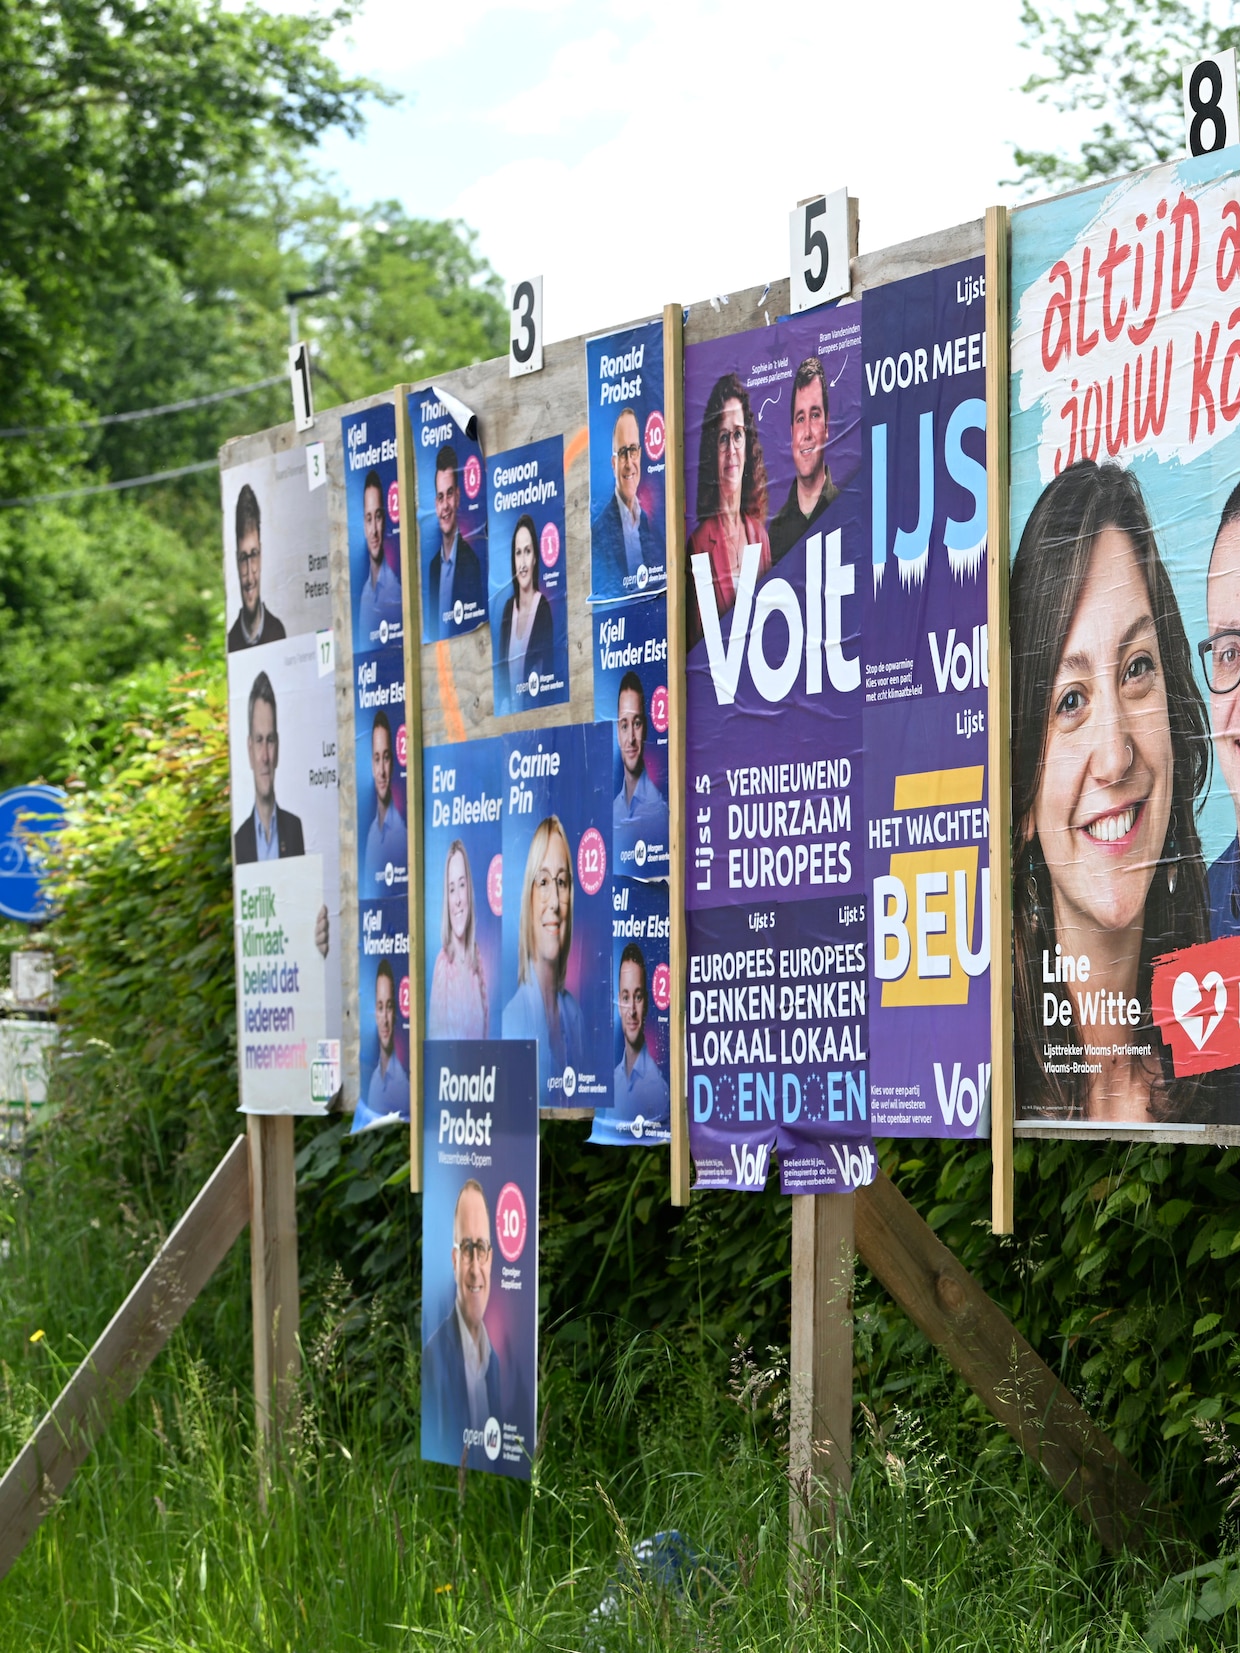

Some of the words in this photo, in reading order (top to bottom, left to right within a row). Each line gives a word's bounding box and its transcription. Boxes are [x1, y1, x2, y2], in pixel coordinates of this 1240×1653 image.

[1188, 59, 1227, 157] 8
[804, 197, 829, 293] 5
[956, 275, 986, 306] Lijst
[512, 281, 536, 364] 3
[600, 344, 644, 379] Ronald
[865, 347, 929, 397] VOOR
[294, 346, 311, 418] 1
[600, 375, 642, 406] Probst
[1054, 340, 1173, 477] jouw
[347, 421, 368, 449] Kjell
[421, 422, 453, 448] Geyns
[649, 428, 662, 446] 10
[469, 469, 476, 485] 6
[493, 460, 539, 488] Gewoon
[493, 479, 558, 513] Gwendolyn.
[308, 554, 328, 573] Bram
[304, 582, 330, 599] Peters
[600, 617, 625, 649] Kjell
[690, 526, 862, 706] Volt
[320, 641, 330, 665] 17
[600, 642, 644, 671] Vander
[643, 637, 668, 664] Elst
[357, 661, 377, 686] Kjell
[358, 685, 390, 709] Vander
[657, 700, 665, 719] 2
[956, 709, 985, 739] Lijst
[322, 740, 336, 758] Luc
[508, 744, 561, 780] Carine
[432, 764, 456, 794] Eva
[695, 774, 711, 794] 5
[726, 757, 852, 796] VERNIEUWEND
[432, 800, 450, 828] De
[451, 792, 503, 826] Bleeker
[508, 783, 534, 815] Pin
[728, 795, 852, 840] DUURZAAM
[868, 817, 903, 849] HET
[584, 848, 598, 873] 12
[695, 806, 715, 890] Lijst
[728, 841, 853, 889] EUROPEES
[241, 884, 276, 928] Eerlijk
[362, 909, 382, 933] Kjell
[749, 912, 768, 932] Lijst
[768, 911, 775, 928] 5
[838, 906, 858, 927] Lijst
[858, 904, 865, 921] 5
[241, 925, 289, 958] klimaat-
[363, 934, 394, 956] Vander
[690, 948, 776, 983] EUROPEES
[779, 943, 866, 979] EUROPEES
[1042, 944, 1091, 983] Line
[243, 963, 278, 996] beleid
[279, 961, 300, 993] dat
[690, 984, 776, 1025] DENKEN
[779, 980, 866, 1021] DENKEN
[1043, 993, 1073, 1028] De
[1076, 988, 1142, 1027] Witte
[244, 1004, 295, 1034] iedereen
[690, 1027, 777, 1066] LOKAAL
[780, 1025, 866, 1064] LOKAAL
[1043, 1044, 1084, 1058] Lijsttrekker
[1084, 1044, 1111, 1056] Vlaams
[1112, 1044, 1152, 1056] Parlement
[438, 1065, 497, 1104] Ronald
[1043, 1062, 1103, 1074] Vlaams-Brabant
[692, 1071, 777, 1123] DOEN
[782, 1069, 867, 1123] DOEN
[933, 1062, 991, 1128] Vol
[438, 1109, 493, 1147] Probst
[829, 1144, 875, 1187] Volt
[502, 1208, 519, 1238] 10
